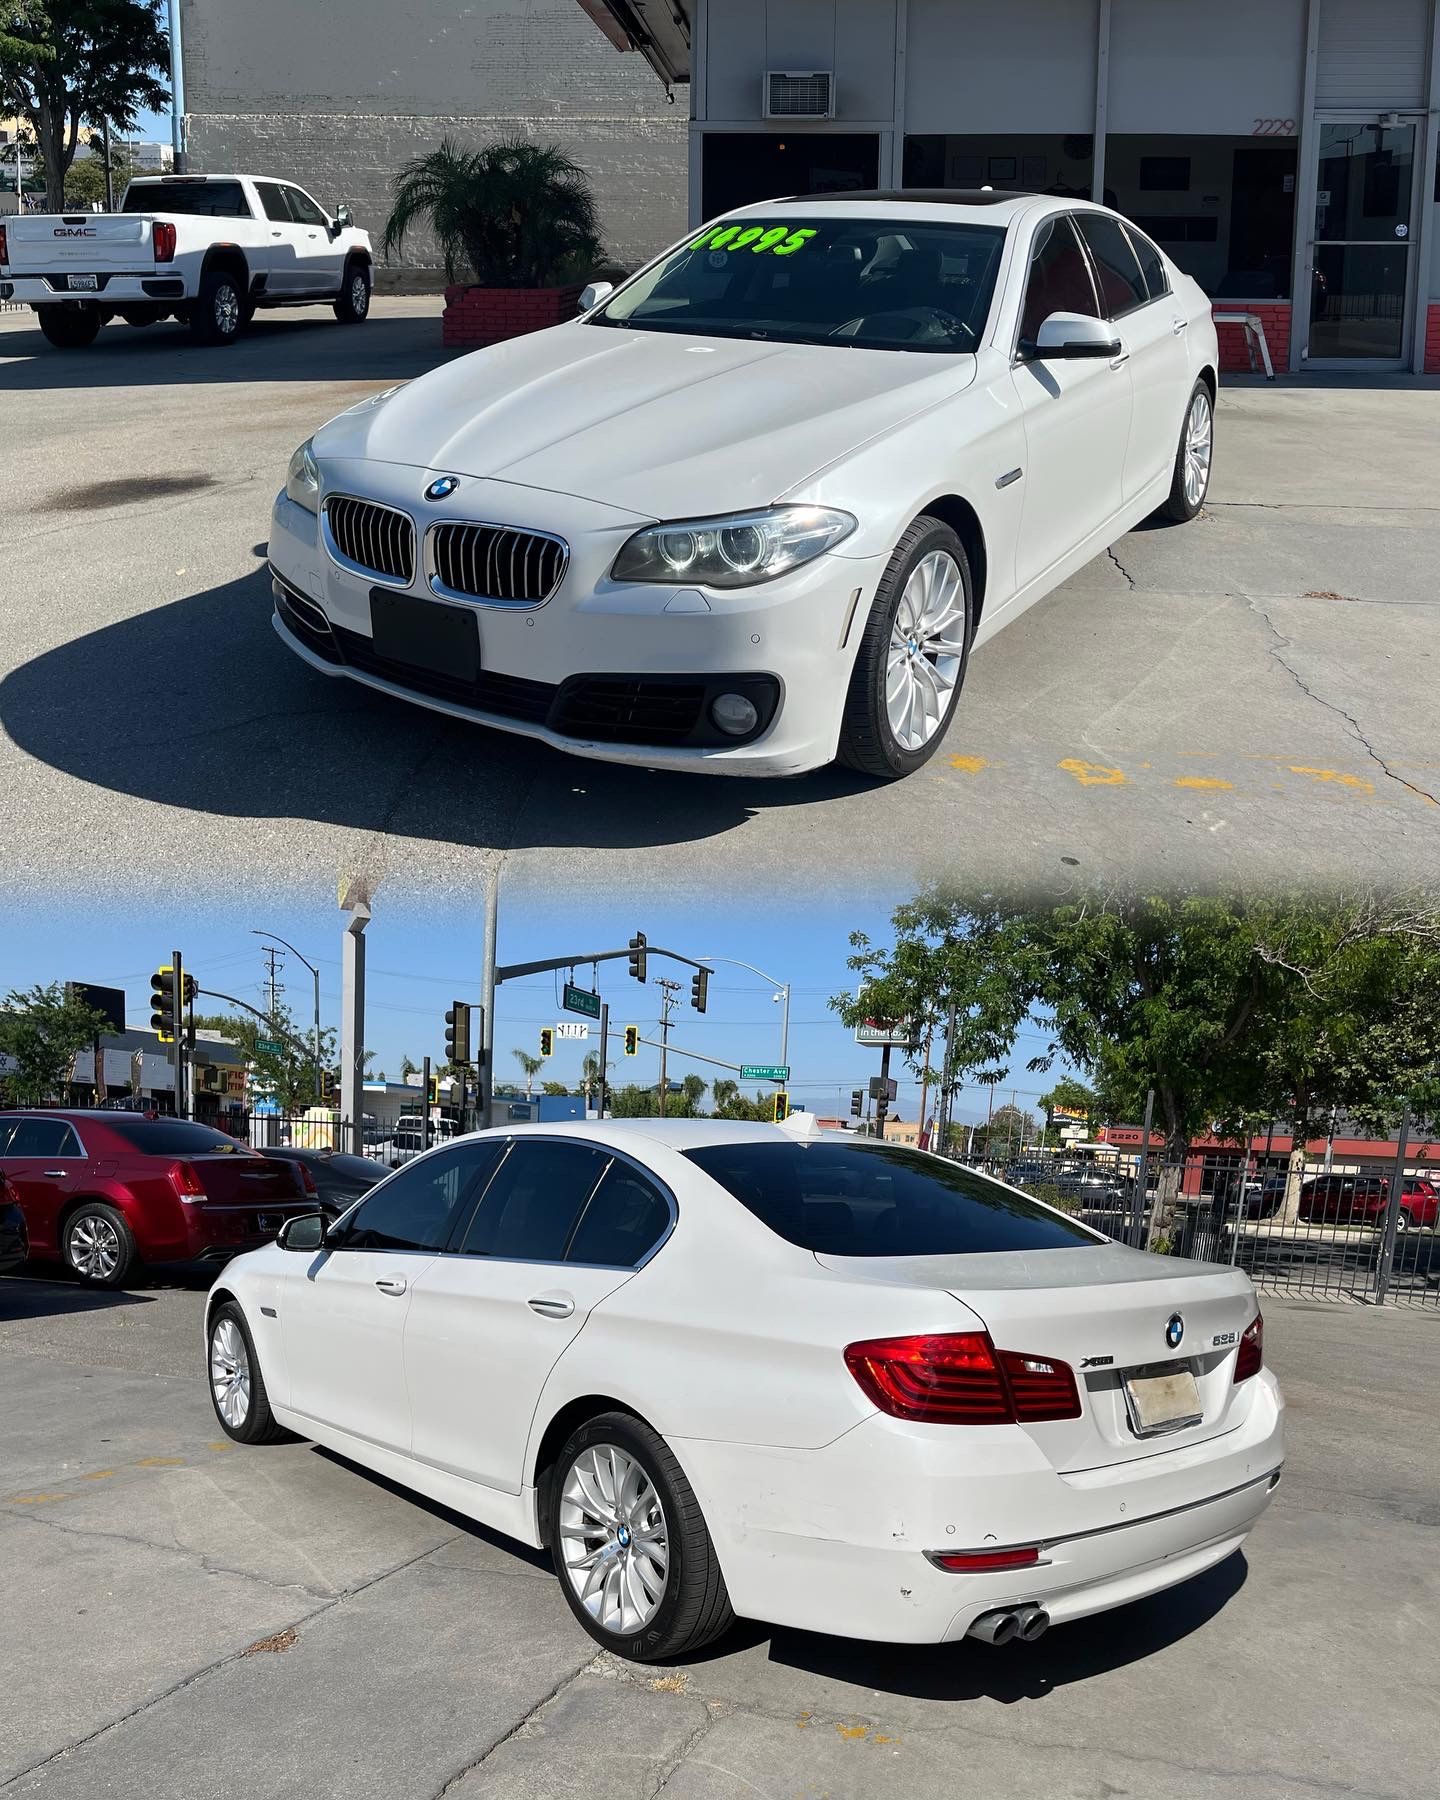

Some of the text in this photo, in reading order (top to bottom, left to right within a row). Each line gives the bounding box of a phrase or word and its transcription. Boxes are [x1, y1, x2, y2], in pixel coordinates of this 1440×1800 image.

[1252, 118, 1296, 136] 2229
[53, 228, 97, 237] GMC
[689, 226, 817, 255] 14995
[570, 993, 585, 1007] 23rd
[870, 1029, 886, 1037] the
[257, 1042, 270, 1050] 23rd
[743, 1067, 770, 1075] Chester
